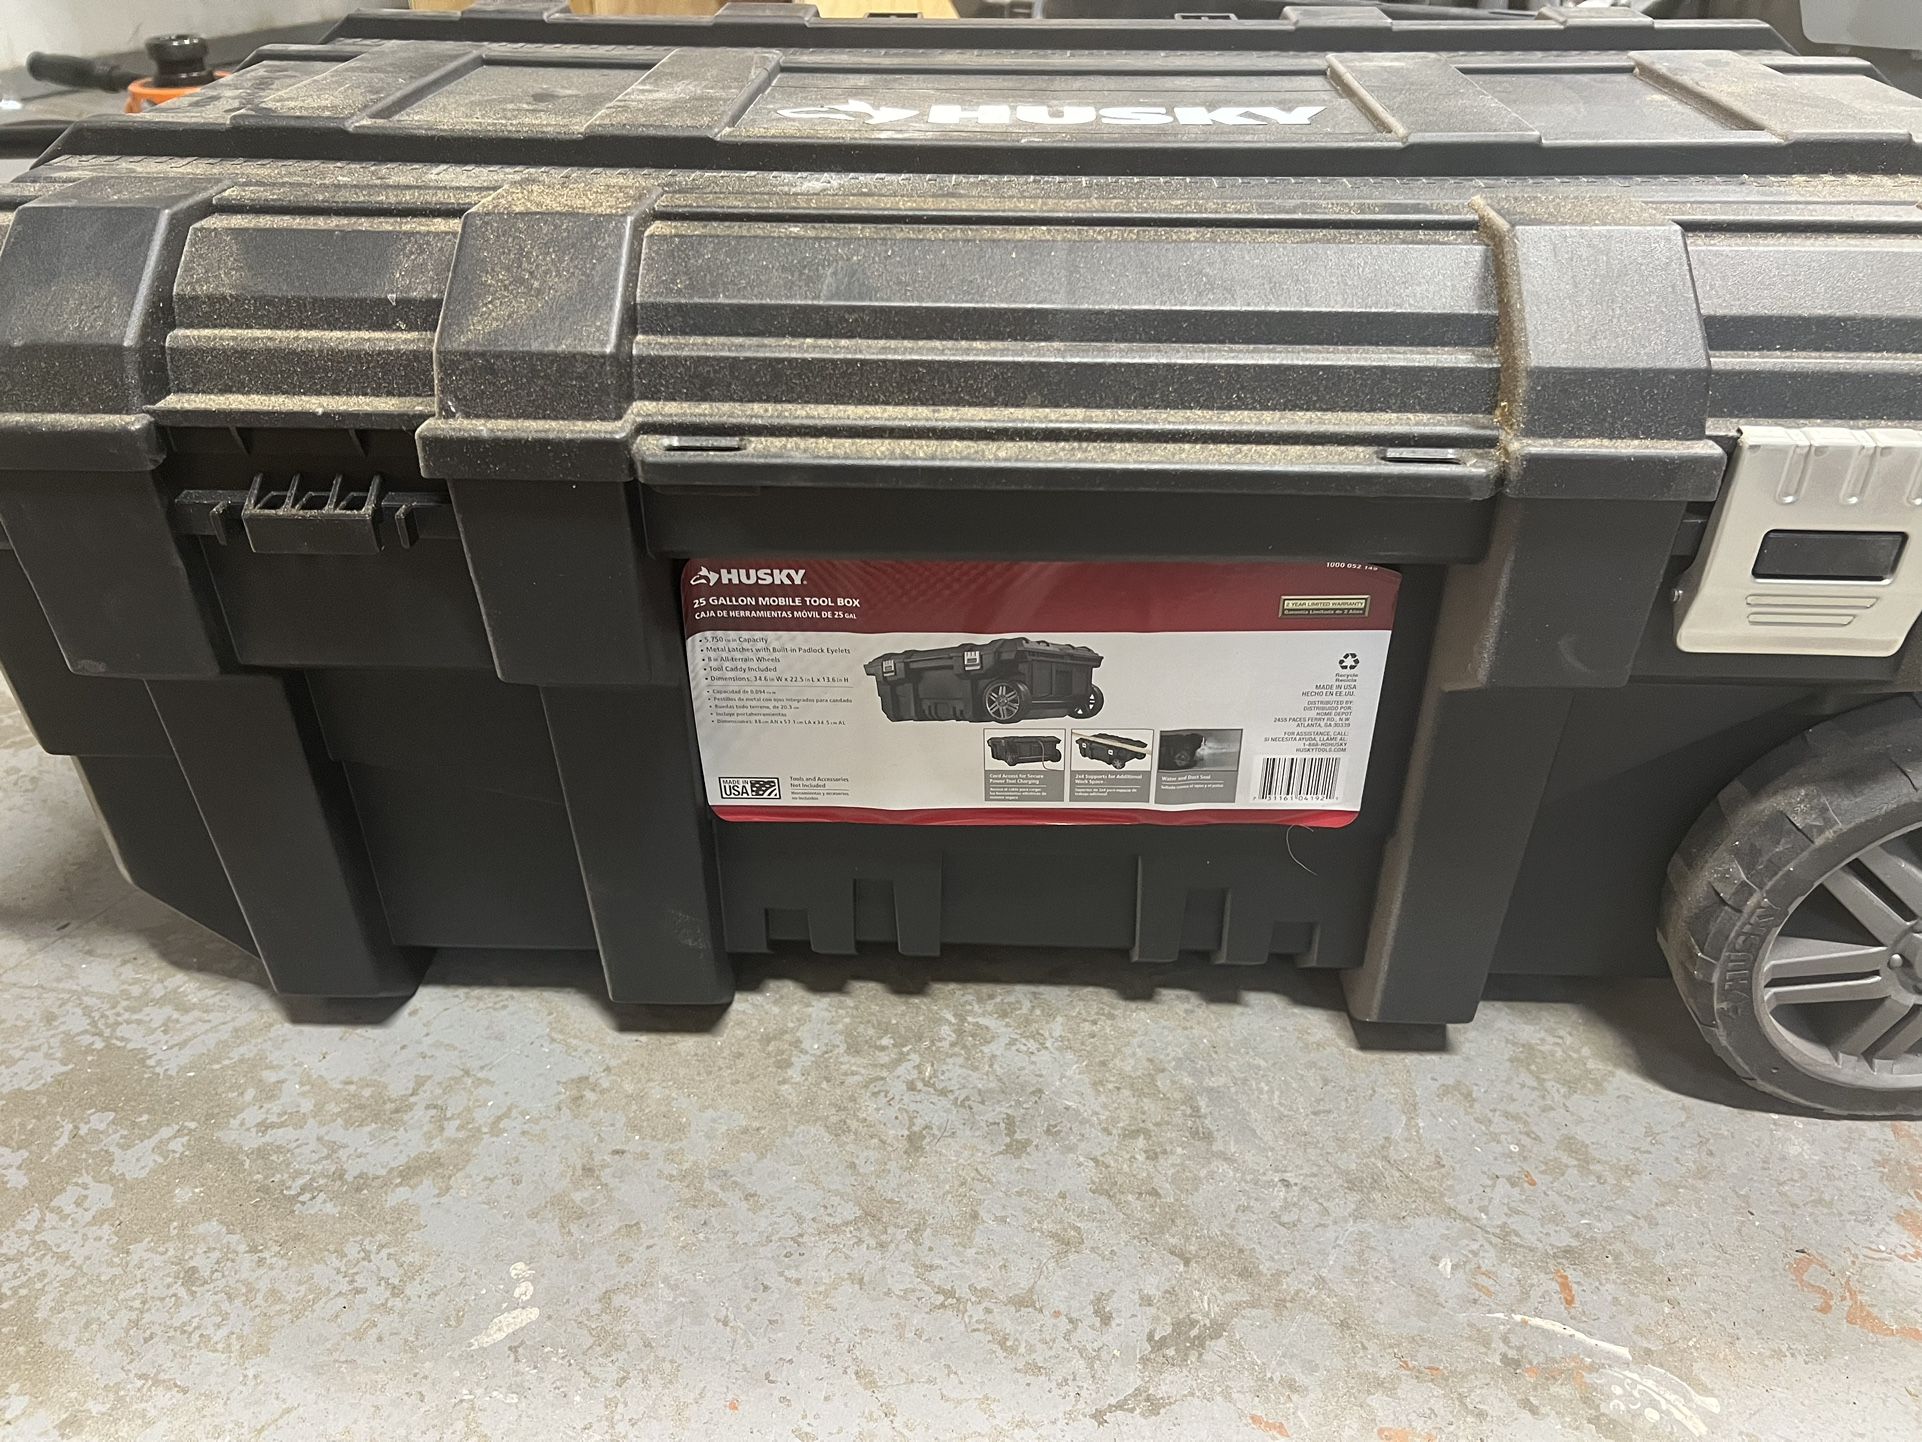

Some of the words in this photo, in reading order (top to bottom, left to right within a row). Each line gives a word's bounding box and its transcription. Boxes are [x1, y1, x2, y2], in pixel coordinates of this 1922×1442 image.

[926, 104, 1328, 126] HUSKY
[720, 568, 806, 585] HUSKY
[693, 596, 706, 608] 25
[708, 596, 756, 606] GALLON
[758, 596, 802, 606] MOBILE
[804, 597, 834, 606] TOOL
[837, 598, 860, 608] BOX
[694, 611, 716, 620] CAJA
[730, 610, 792, 618] HERRAMIENTAS
[794, 610, 820, 618] MÓVIL
[834, 611, 844, 619] 25
[738, 636, 768, 644] Capacity
[723, 784, 750, 797] USA
